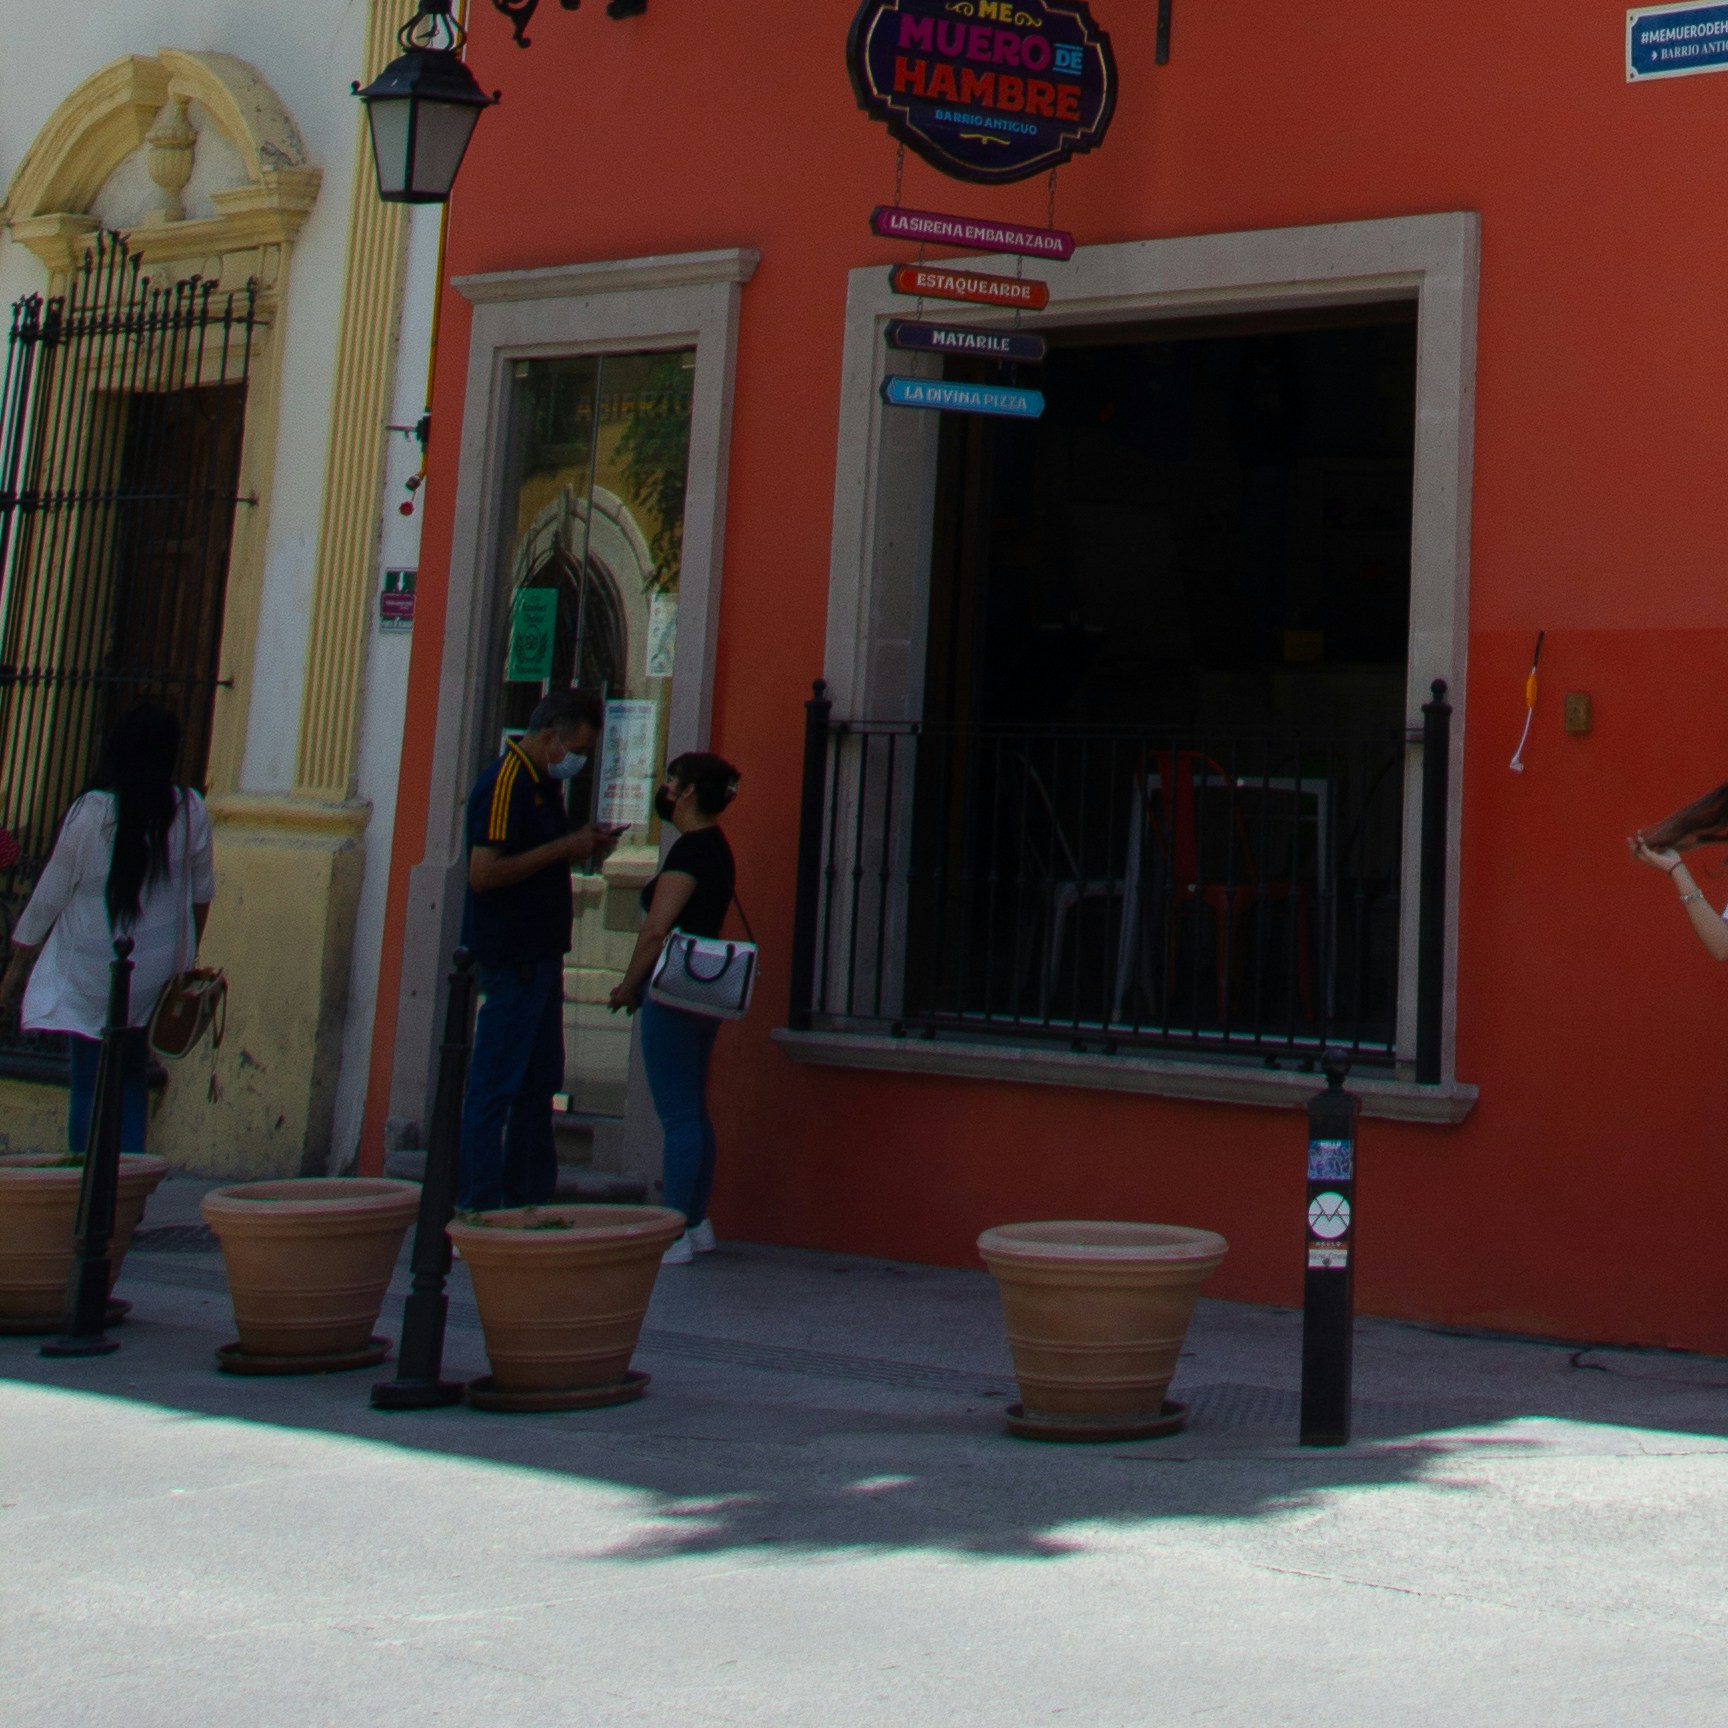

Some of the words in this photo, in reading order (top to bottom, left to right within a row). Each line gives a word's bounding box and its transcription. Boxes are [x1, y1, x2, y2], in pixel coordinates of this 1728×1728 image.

[978, 0, 1014, 24] ME
[898, 14, 1052, 72] MUERO
[1055, 46, 1084, 71] DE
[1661, 42, 1701, 62] BARRIO
[892, 57, 1082, 121] HAMBRE
[934, 109, 983, 127] BARRIO
[984, 116, 1038, 136] ANTIGUO
[890, 215, 911, 231] LA
[910, 217, 965, 238] SIRENA
[964, 226, 1064, 253] EMBARAZADA
[916, 272, 1032, 300] ESTAQUEARDE
[932, 330, 1011, 352] MATARILE
[904, 385, 924, 401] LA
[925, 387, 982, 407] DIVINA
[983, 392, 1028, 411] PIZZA
